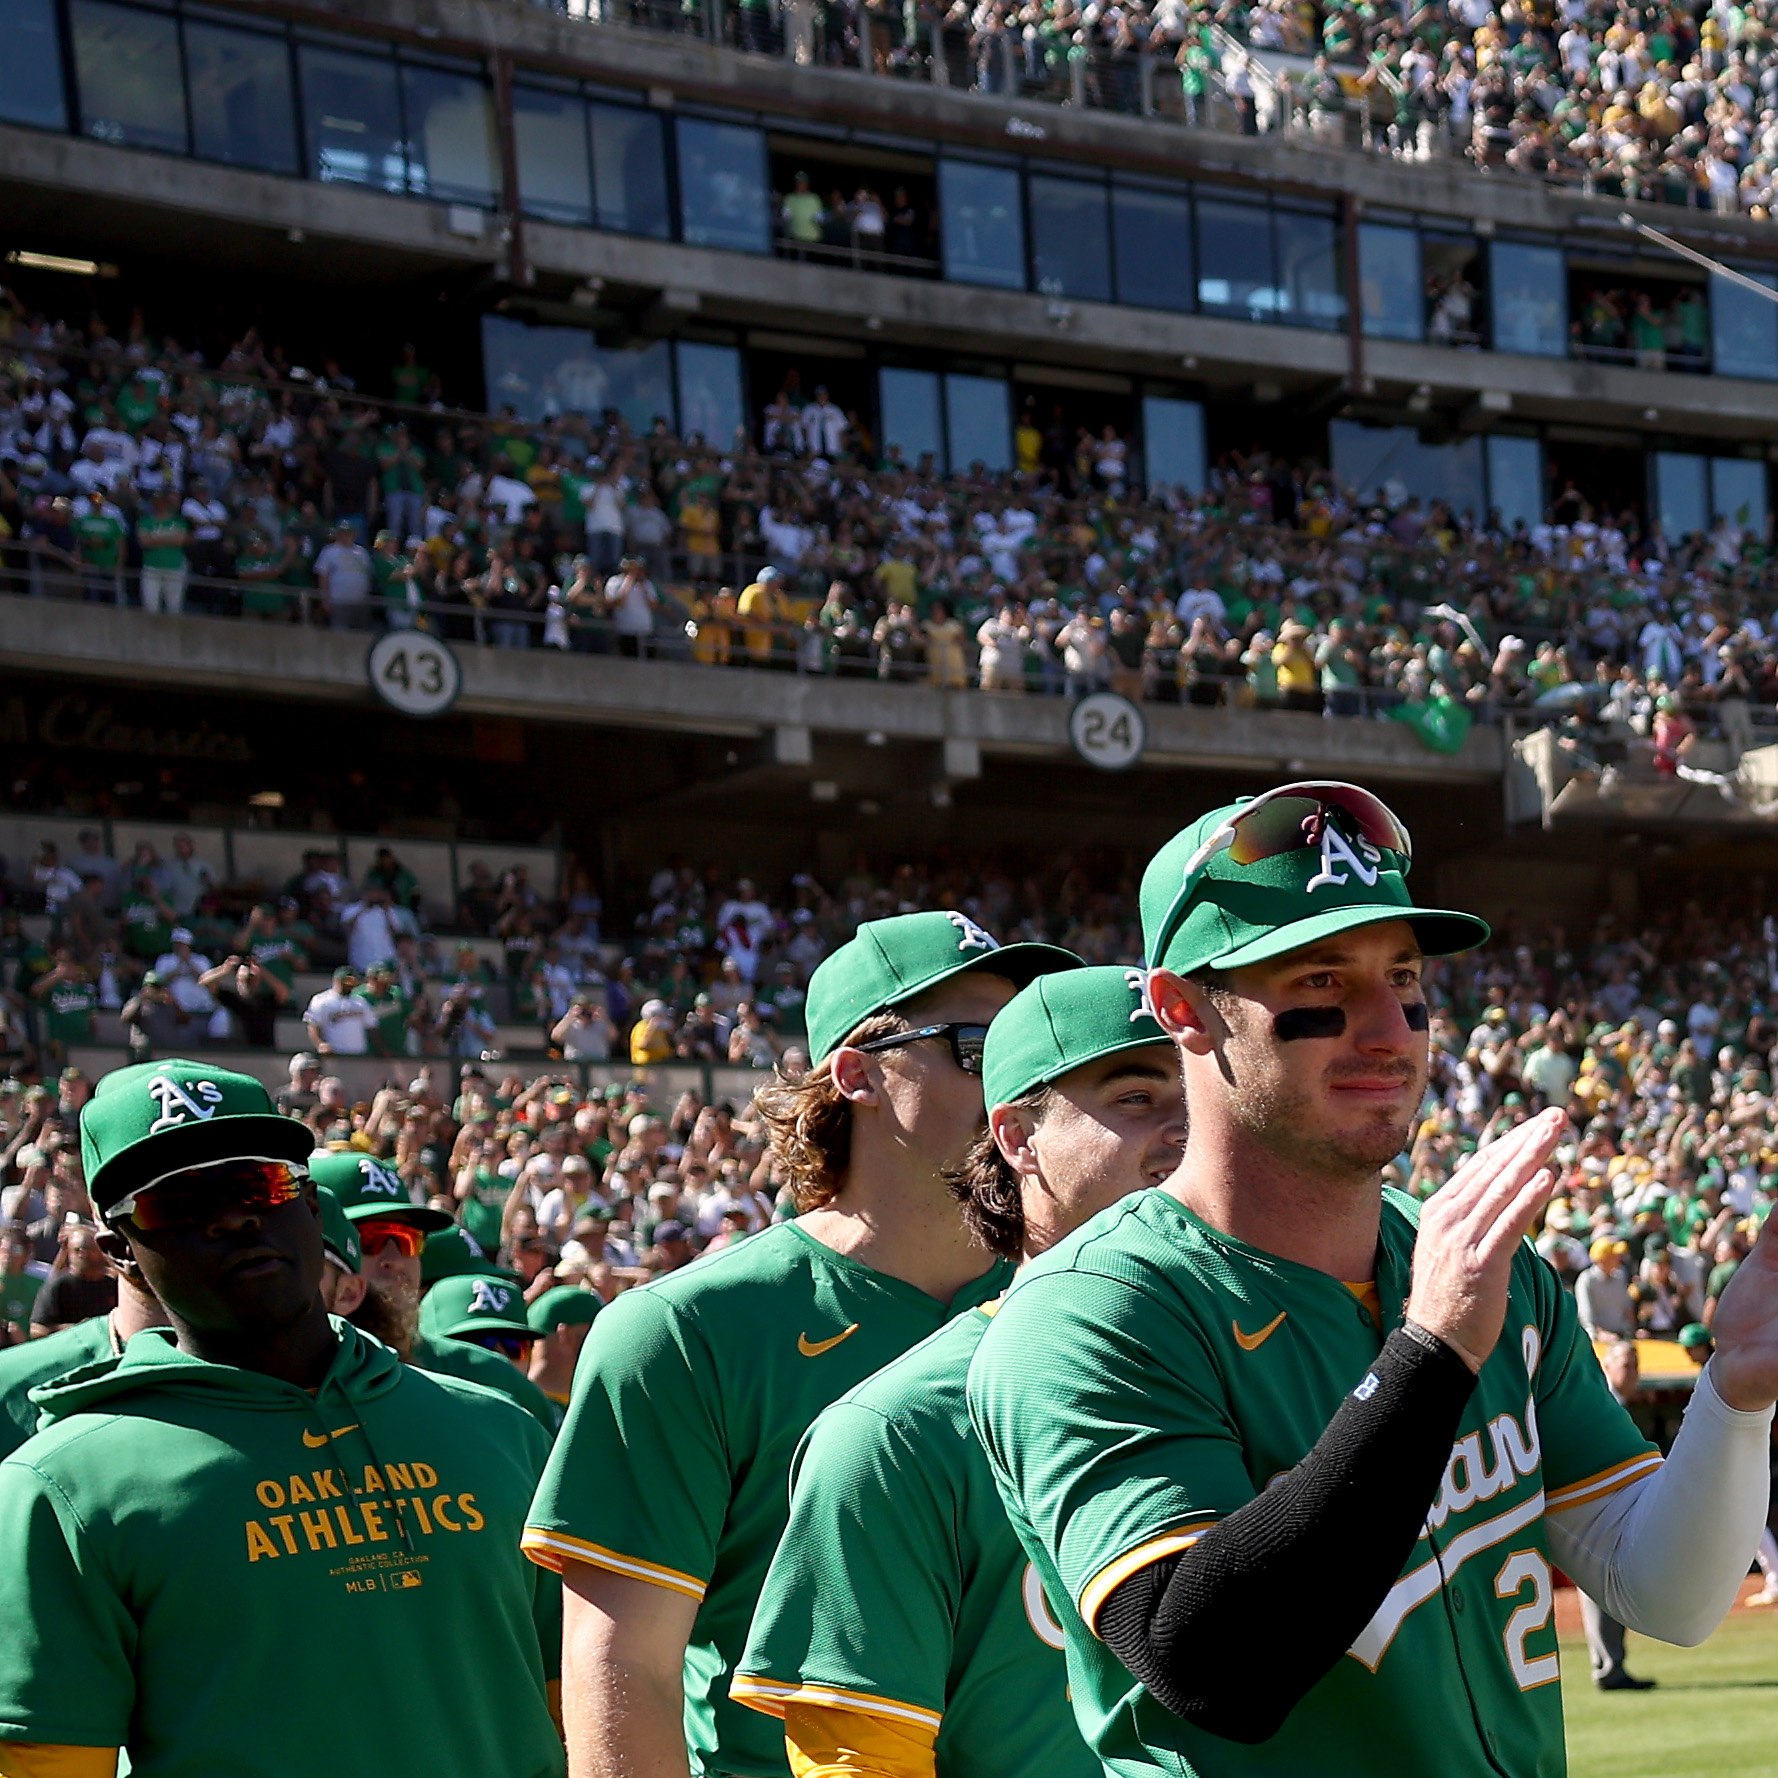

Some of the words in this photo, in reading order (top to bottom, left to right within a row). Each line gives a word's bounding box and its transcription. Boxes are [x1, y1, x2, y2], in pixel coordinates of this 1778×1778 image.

[383, 649, 444, 696] 43
[1083, 710, 1131, 749] 24
[1301, 812, 1381, 893] A's
[148, 1075, 223, 1135] A's
[358, 1158, 400, 1196] A's
[467, 1279, 511, 1314] A's
[245, 1492, 486, 1563] ATHLETICS
[345, 1578, 377, 1593] MLB
